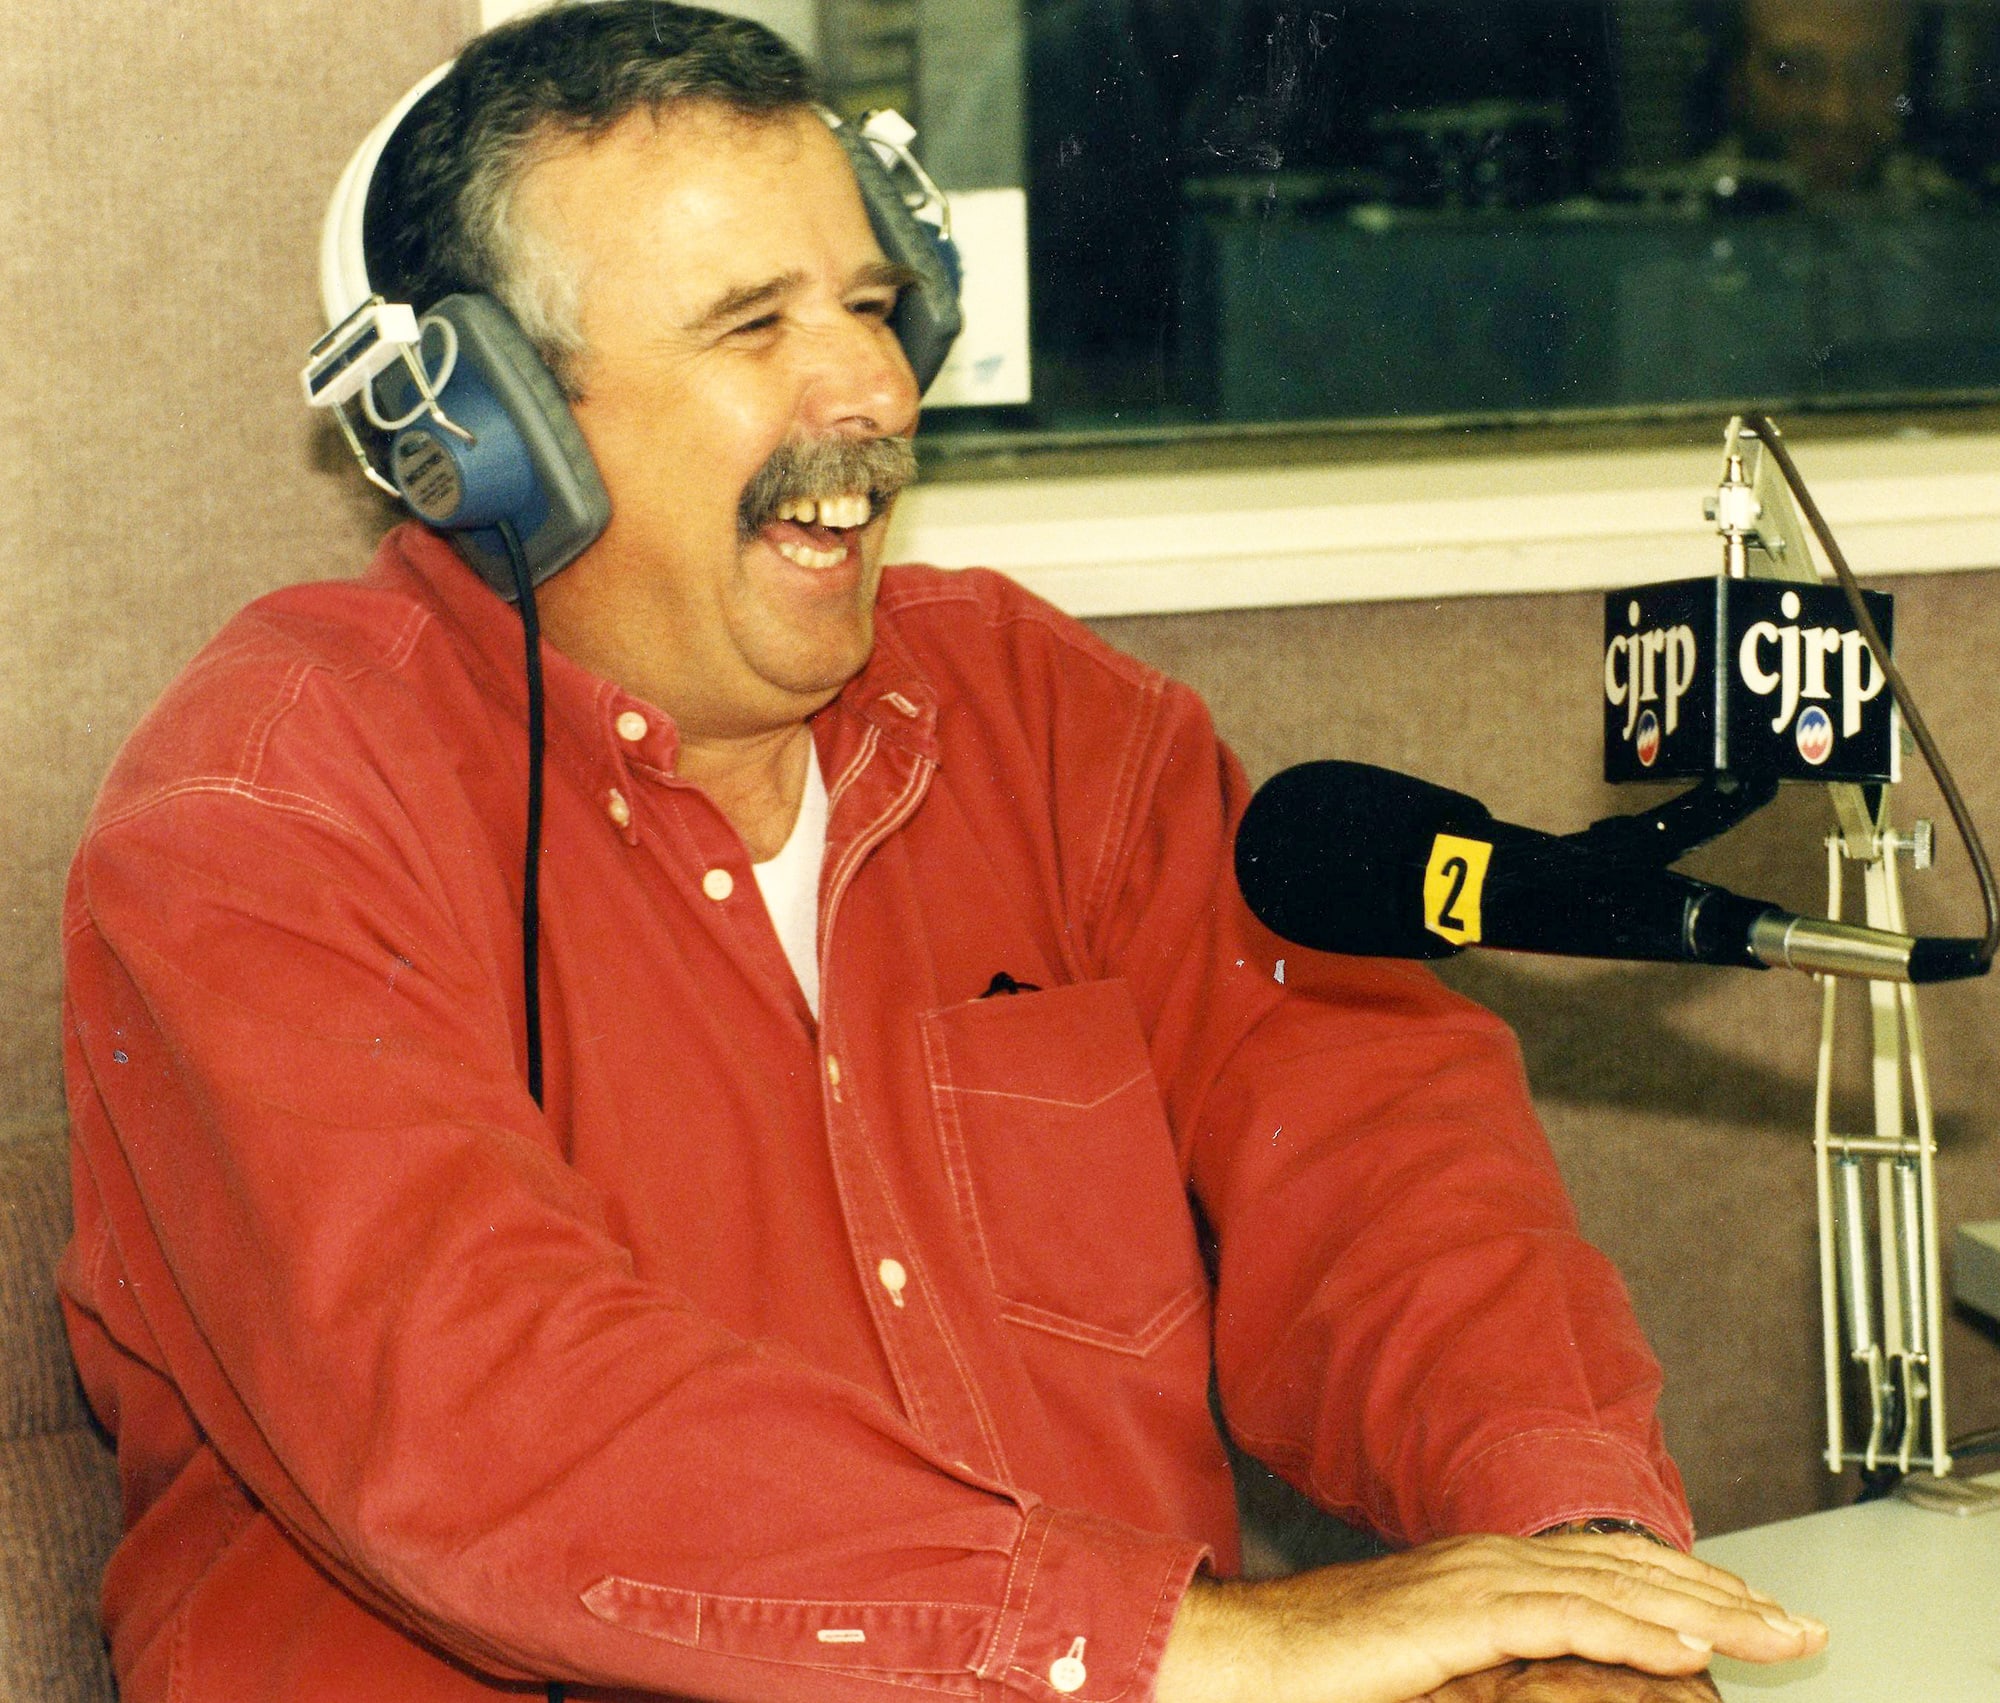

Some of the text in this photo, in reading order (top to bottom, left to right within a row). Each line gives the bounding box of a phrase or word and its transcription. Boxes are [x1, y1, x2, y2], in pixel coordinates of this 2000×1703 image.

[1604, 600, 1697, 741] cjrp
[1739, 591, 1887, 739] cjrp
[1438, 856, 1468, 932] 2
